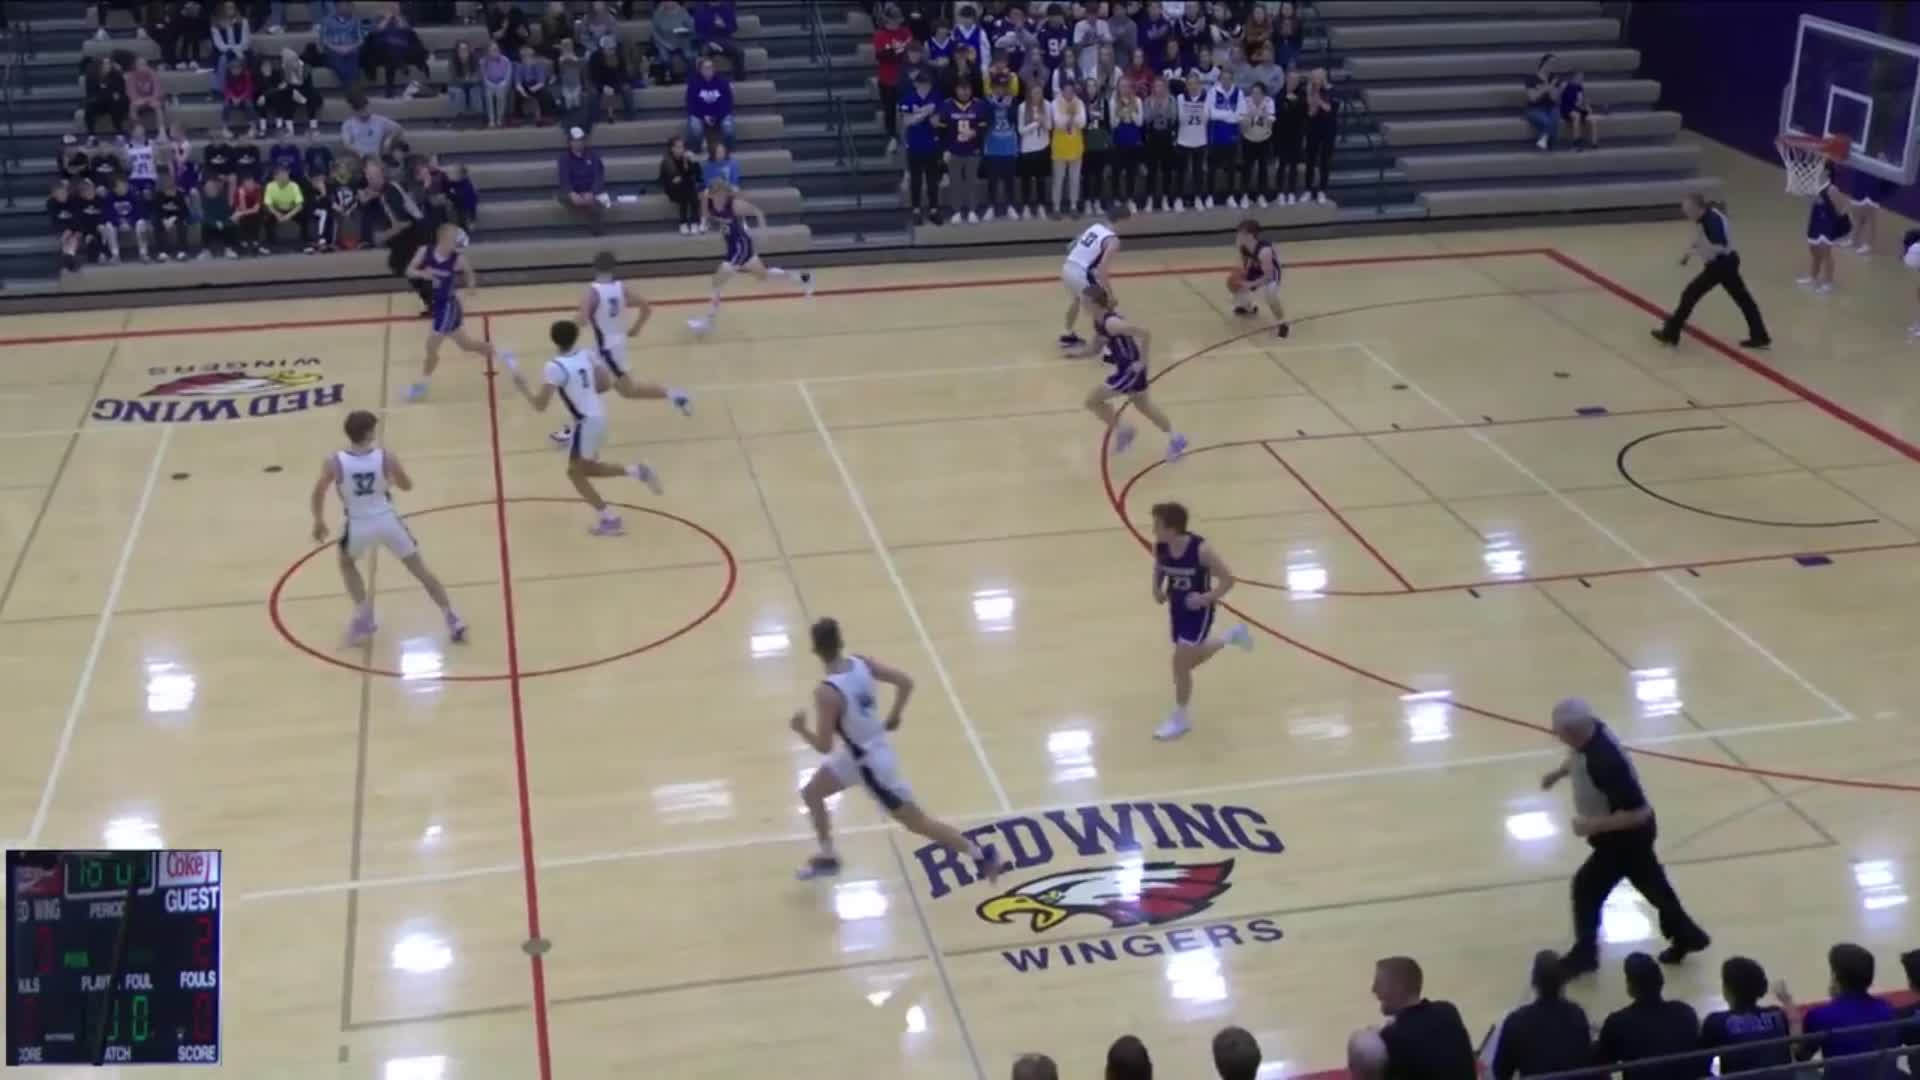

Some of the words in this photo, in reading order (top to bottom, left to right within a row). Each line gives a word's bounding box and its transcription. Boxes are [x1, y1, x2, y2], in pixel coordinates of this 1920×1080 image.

[92, 397, 241, 423] WING
[247, 383, 345, 418] RED
[351, 471, 376, 497] 32
[914, 814, 1054, 900] RED
[1044, 802, 1286, 856] WING
[1002, 919, 1284, 973] WINGERS
